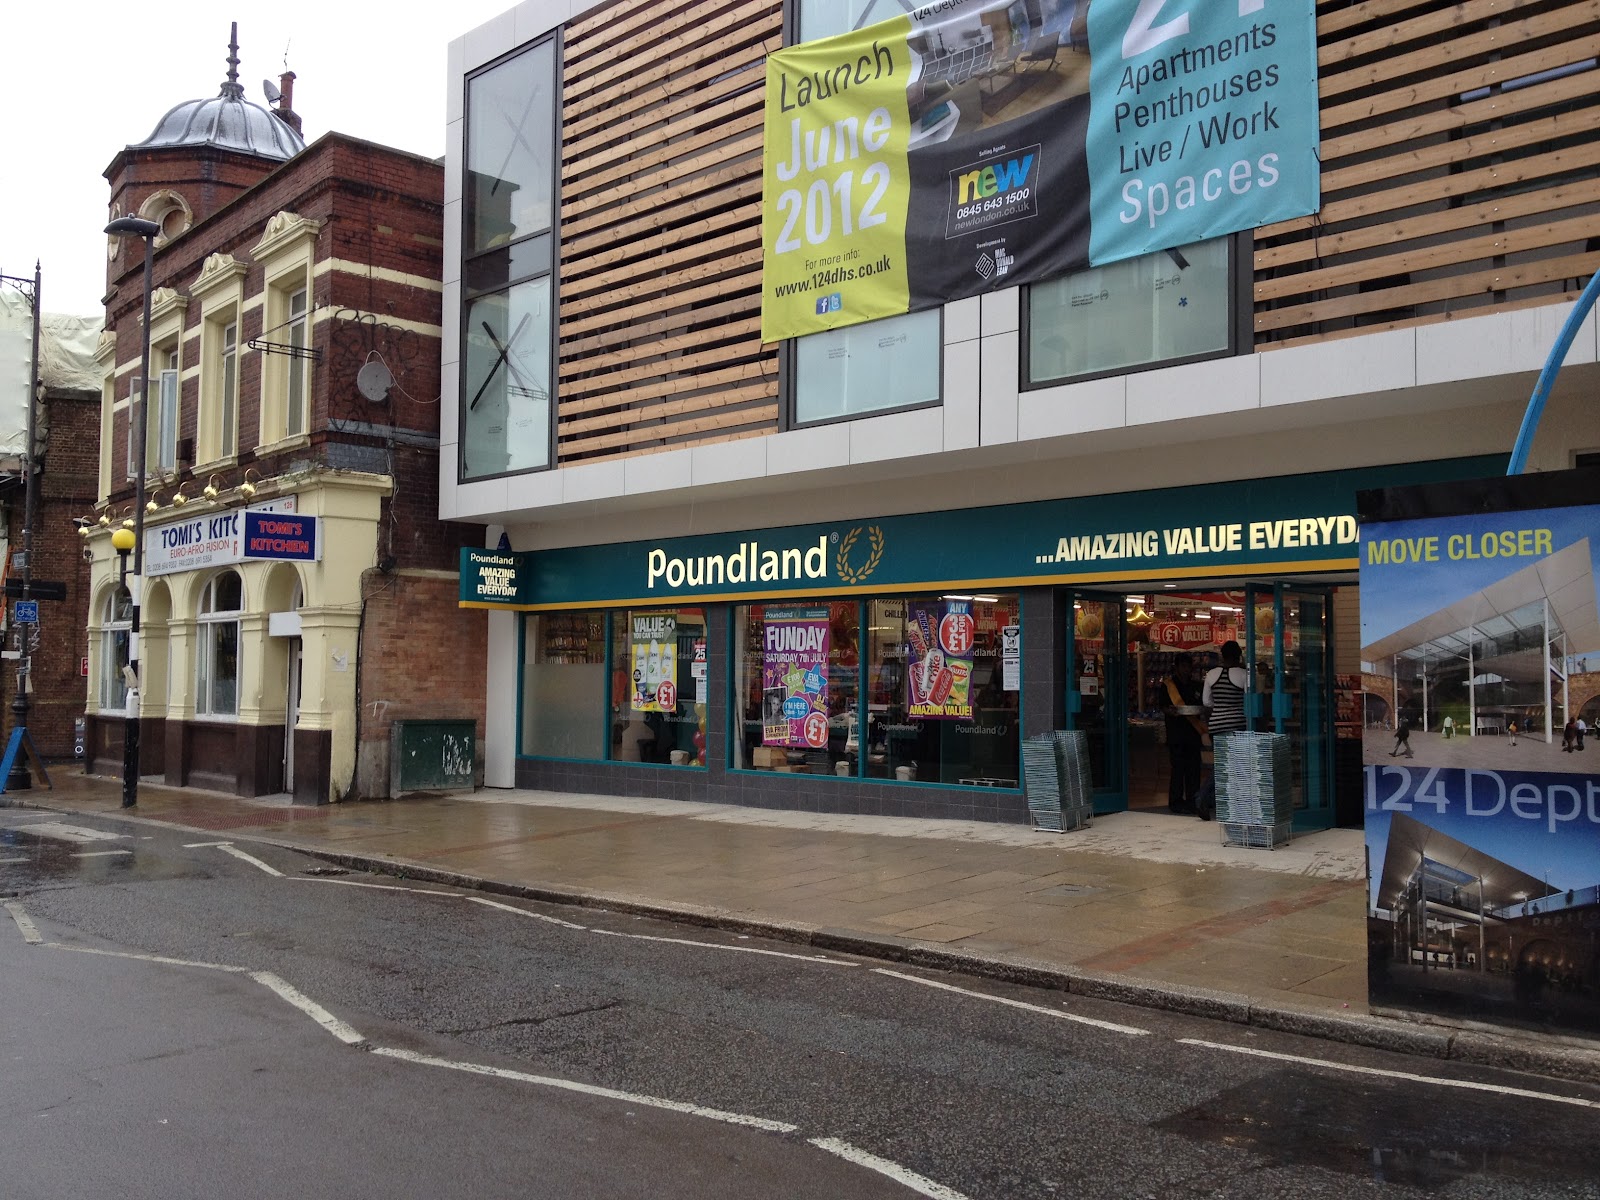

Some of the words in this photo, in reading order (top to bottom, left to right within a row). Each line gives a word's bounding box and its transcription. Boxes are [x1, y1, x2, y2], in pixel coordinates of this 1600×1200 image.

[1117, 23, 1276, 96] Apartments
[780, 40, 894, 114] Launch
[1115, 63, 1279, 133] Penthouses
[776, 107, 892, 182] June
[958, 153, 1034, 205] new
[1119, 152, 1279, 229] Spaces
[775, 162, 891, 255] 2012
[956, 203, 981, 219] 0845
[983, 197, 1003, 212] 643
[1005, 188, 1030, 205] 1500
[954, 201, 1030, 231] newlondon.co.uk
[805, 258, 817, 271] For
[819, 255, 841, 267] more
[843, 248, 860, 262] info:
[775, 254, 891, 298] www.124dhs.co.uk
[161, 521, 202, 549] TOMI'S
[209, 514, 238, 540] KITC
[258, 520, 303, 536] TOMI'S
[1162, 523, 1242, 555] VALUE
[1249, 514, 1360, 550] EVERYD
[206, 539, 230, 553] FUSION
[250, 537, 310, 554] KITCHEN
[1367, 536, 1440, 565] MOVE
[1447, 528, 1553, 561] CLOSER
[470, 552, 514, 565] Poundland
[647, 535, 828, 589] Poundland
[479, 566, 516, 579] AMAZING
[484, 576, 510, 587] VALUE
[477, 584, 517, 597] EVERYDAY
[765, 610, 793, 618] Poundland
[949, 602, 967, 614] ANY
[633, 616, 665, 632] VALUE
[958, 615, 966, 633] FOR
[766, 625, 827, 653] FUNDAY
[948, 632, 966, 651] £1
[1165, 629, 1178, 642] £1
[1182, 630, 1212, 641] VALUE!
[694, 648, 706, 660] 25
[766, 653, 798, 663] SATURDAY
[799, 653, 810, 663] 7th
[810, 653, 827, 663] JULY
[1083, 660, 1095, 674] 25
[659, 685, 674, 706] £1
[793, 702, 806, 710] HERE
[909, 705, 944, 716] AMAZING
[944, 705, 973, 716] VALUE!
[808, 718, 827, 743] £1
[955, 724, 997, 735] Poundland
[1363, 765, 1450, 814] 124
